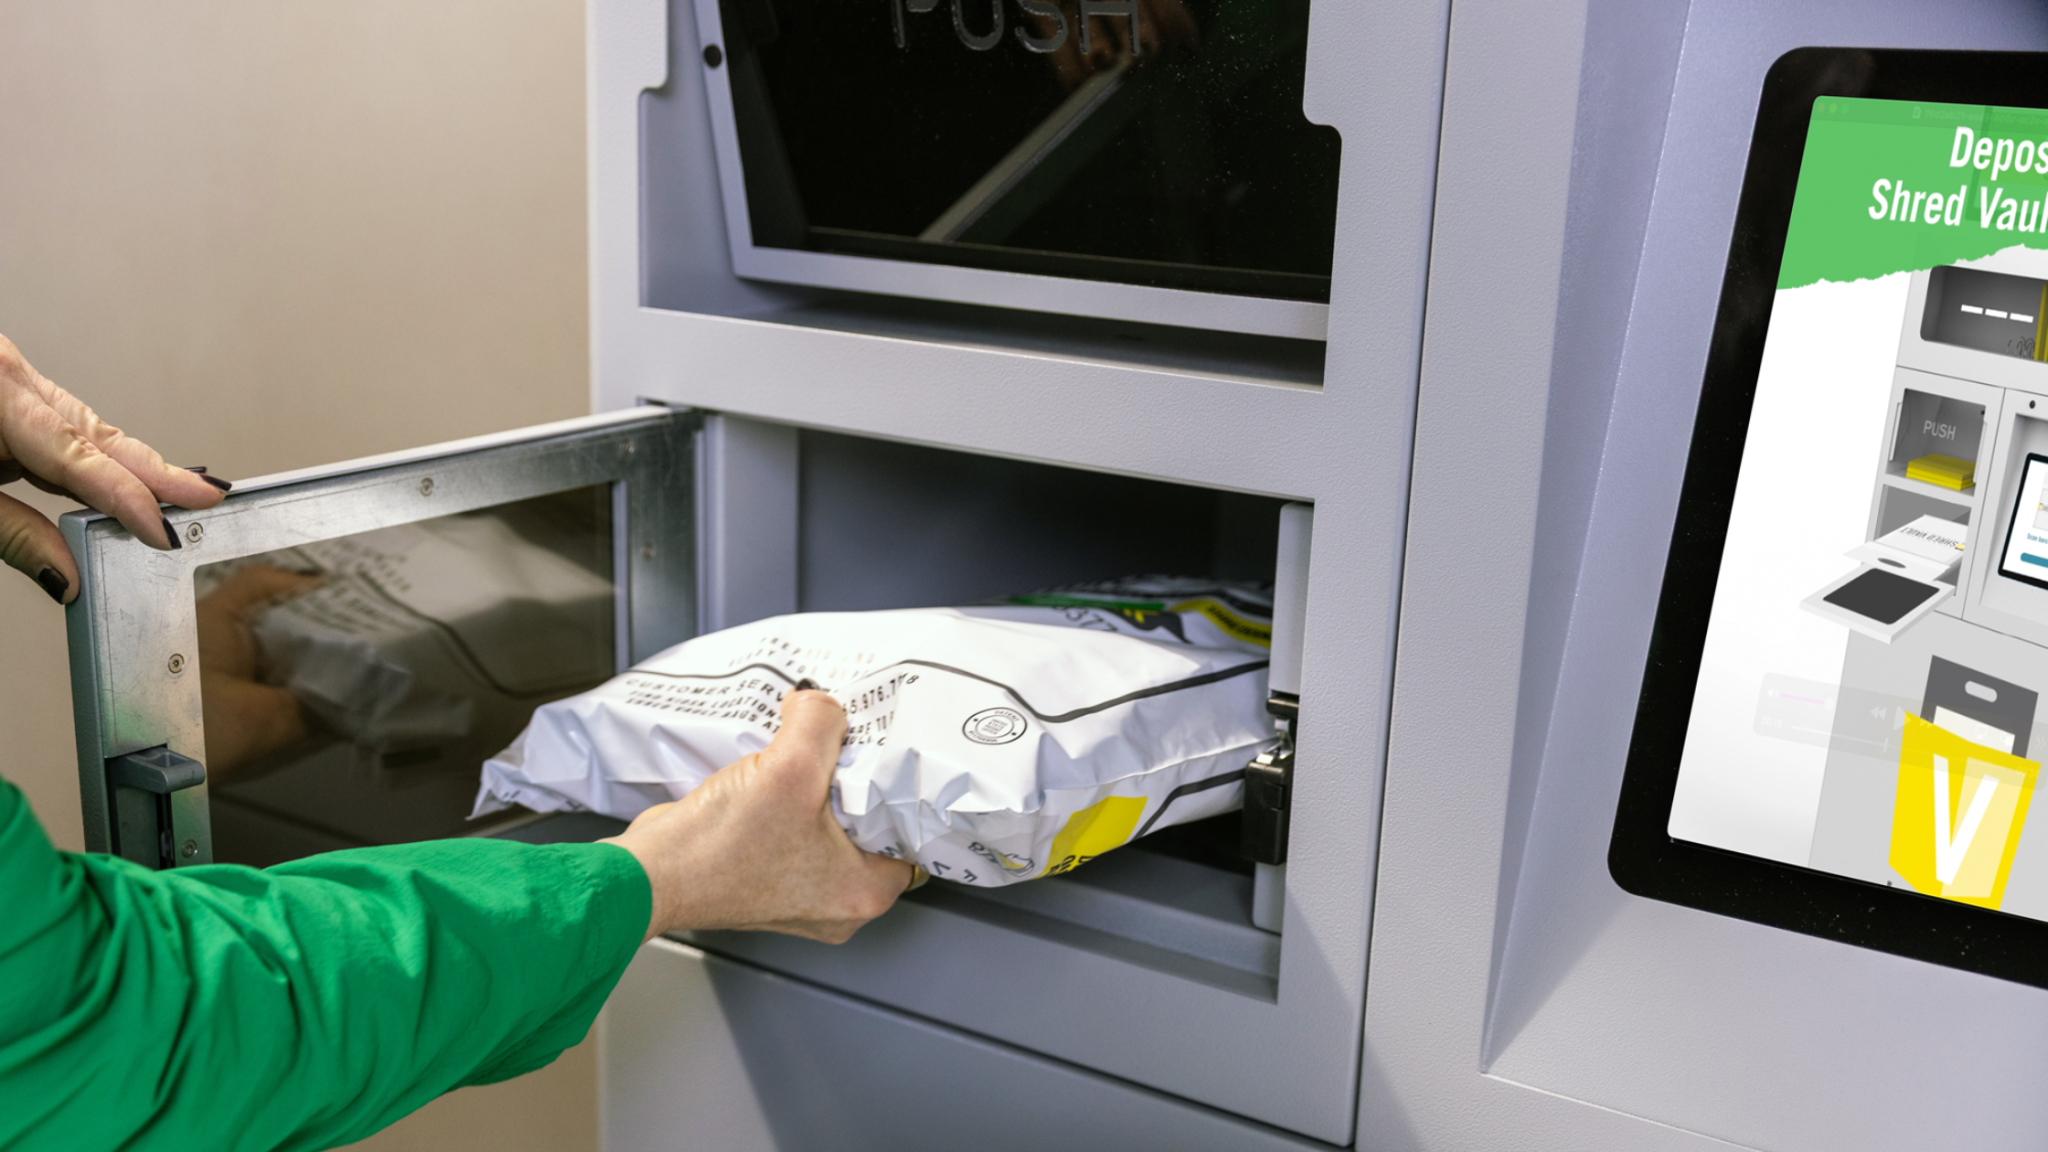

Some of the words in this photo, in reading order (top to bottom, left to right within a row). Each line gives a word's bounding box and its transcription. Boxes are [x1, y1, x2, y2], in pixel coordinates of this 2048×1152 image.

[891, 0, 1141, 55] PUSH
[1949, 126, 2048, 181] Depos
[1868, 178, 1967, 226] Shred
[1923, 420, 1956, 440] PUSH
[625, 678, 731, 696] CUSTOMER
[736, 679, 786, 702] SERV
